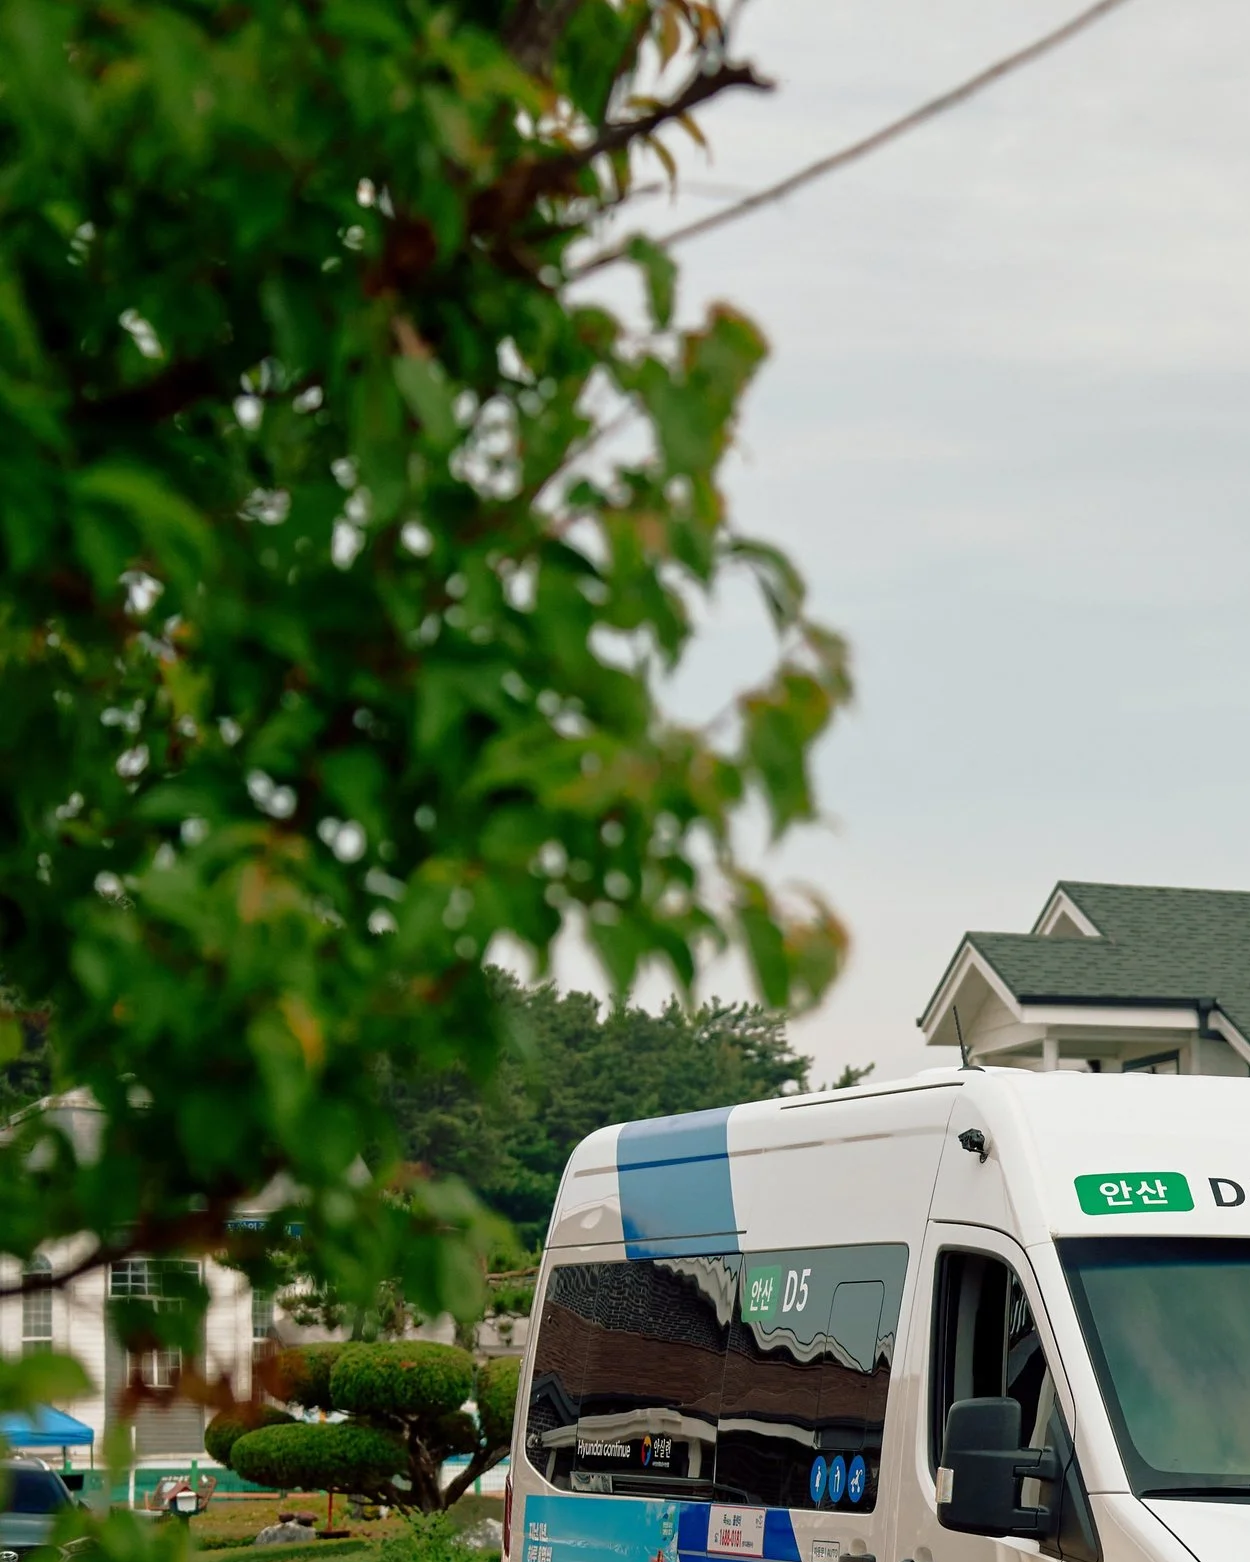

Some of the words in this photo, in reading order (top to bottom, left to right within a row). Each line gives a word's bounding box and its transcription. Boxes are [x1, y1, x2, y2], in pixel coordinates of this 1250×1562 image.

[1099, 1179, 1169, 1207] 안산
[749, 1276, 774, 1312] 안산
[782, 1268, 812, 1313] D5
[577, 1439, 604, 1459] Hyundai
[604, 1440, 631, 1458] continue
[653, 1438, 672, 1459] 안실련
